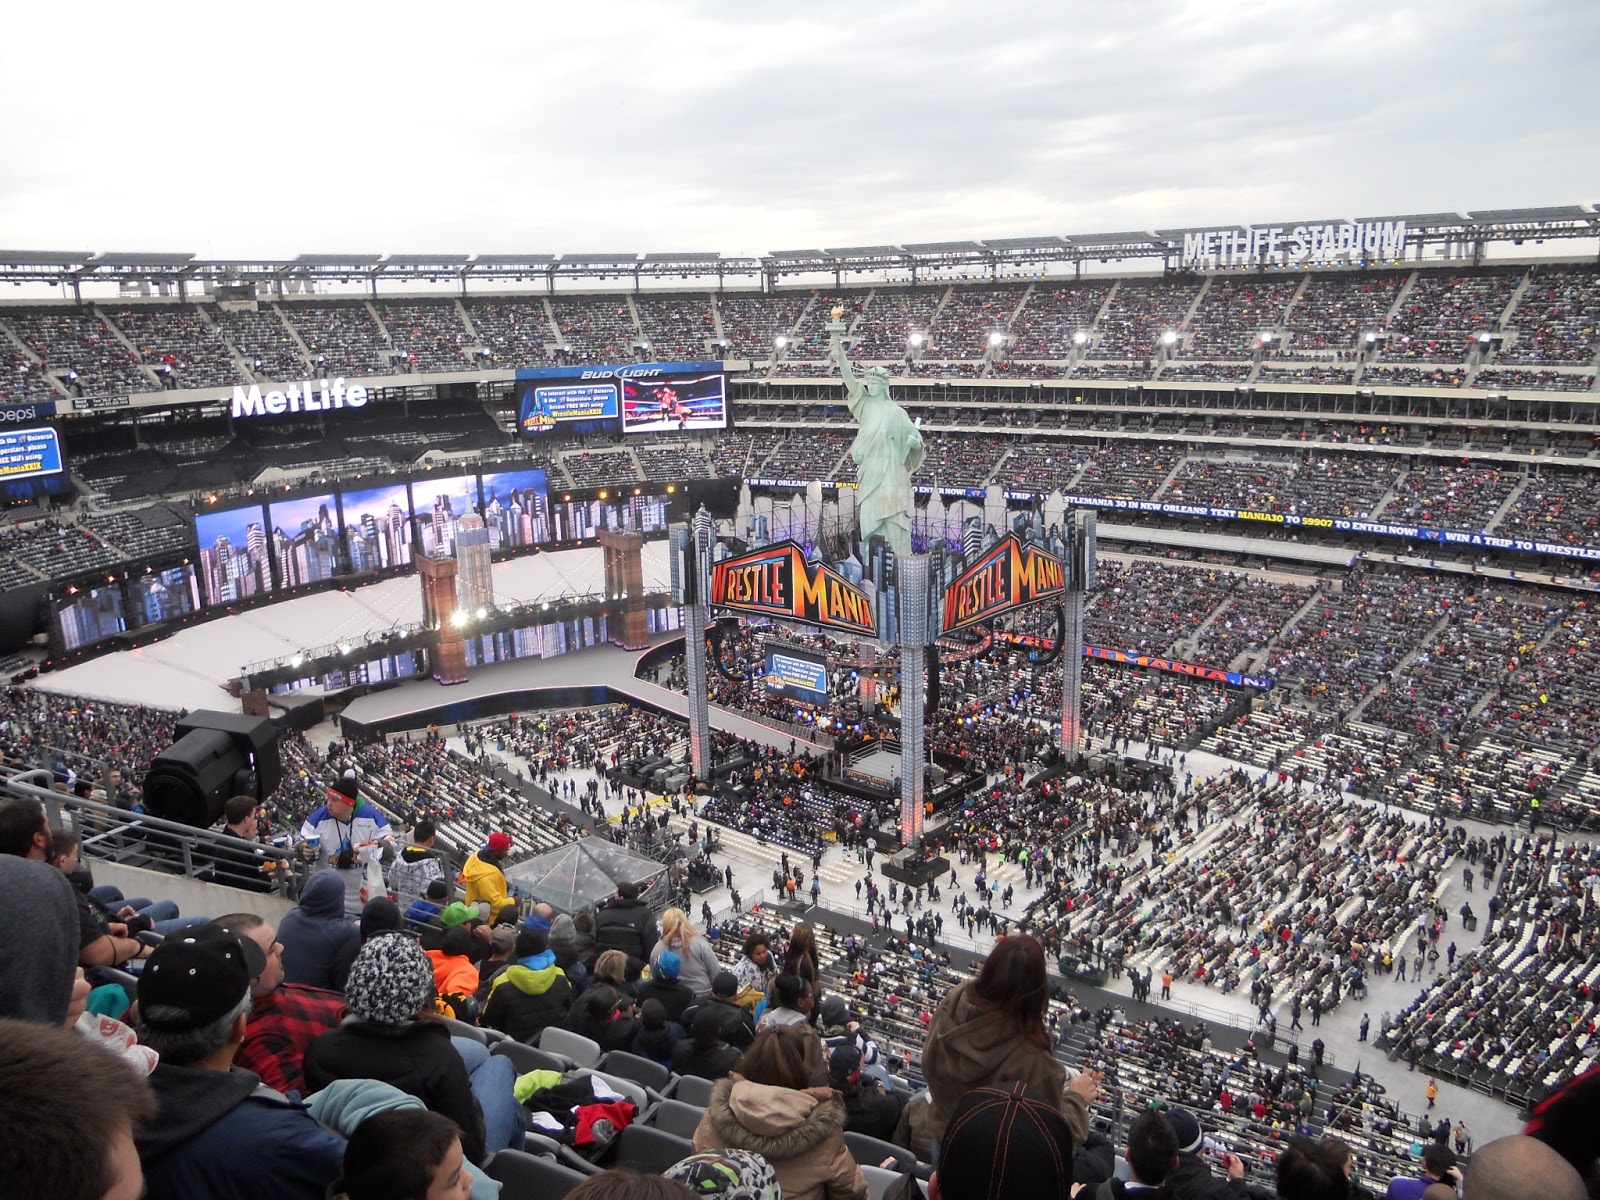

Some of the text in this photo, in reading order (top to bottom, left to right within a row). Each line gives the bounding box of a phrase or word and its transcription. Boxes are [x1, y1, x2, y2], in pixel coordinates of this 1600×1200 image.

[1183, 228, 1283, 260] METLIFE
[1290, 221, 1406, 256] STADIUM
[580, 369, 662, 380] BUD LIGHT
[232, 377, 368, 418] MetLife
[945, 487, 966, 496] NOW!
[1140, 502, 1160, 510] NEW
[1163, 505, 1207, 515] ORLEANS!
[1211, 509, 1236, 518] TEXT
[1238, 511, 1284, 522] MANIA30
[1286, 515, 1300, 524] TO
[1302, 517, 1333, 527] 59907
[1335, 520, 1350, 529] TO
[1352, 523, 1387, 533] ENTER
[1388, 526, 1418, 537] NOW!
[1445, 532, 1469, 543] WIN
[1484, 537, 1513, 548] TRIP
[1515, 540, 1533, 550] TO
[1116, 651, 1228, 682] MANIA
